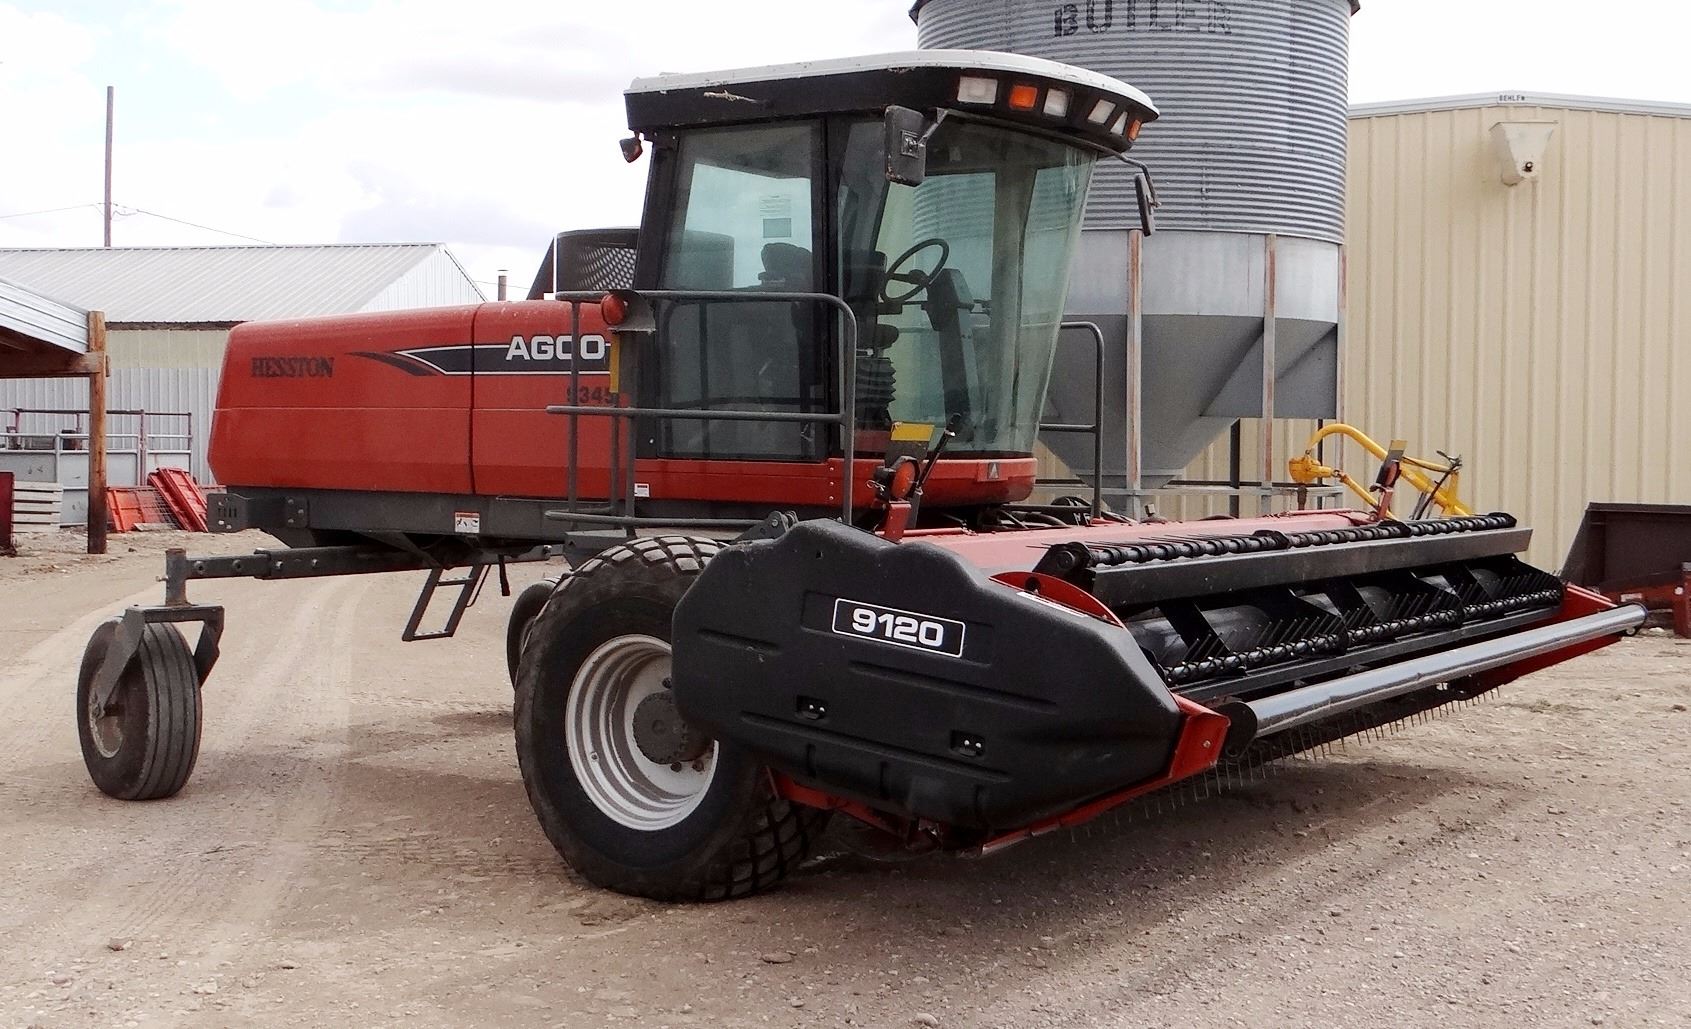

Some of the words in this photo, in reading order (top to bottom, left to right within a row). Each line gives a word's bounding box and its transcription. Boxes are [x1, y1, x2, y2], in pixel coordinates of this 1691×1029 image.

[1054, 0, 1232, 37] BUTLER
[505, 334, 605, 361] AGCO
[251, 357, 335, 377] HESSTON
[852, 608, 944, 647] 9120
